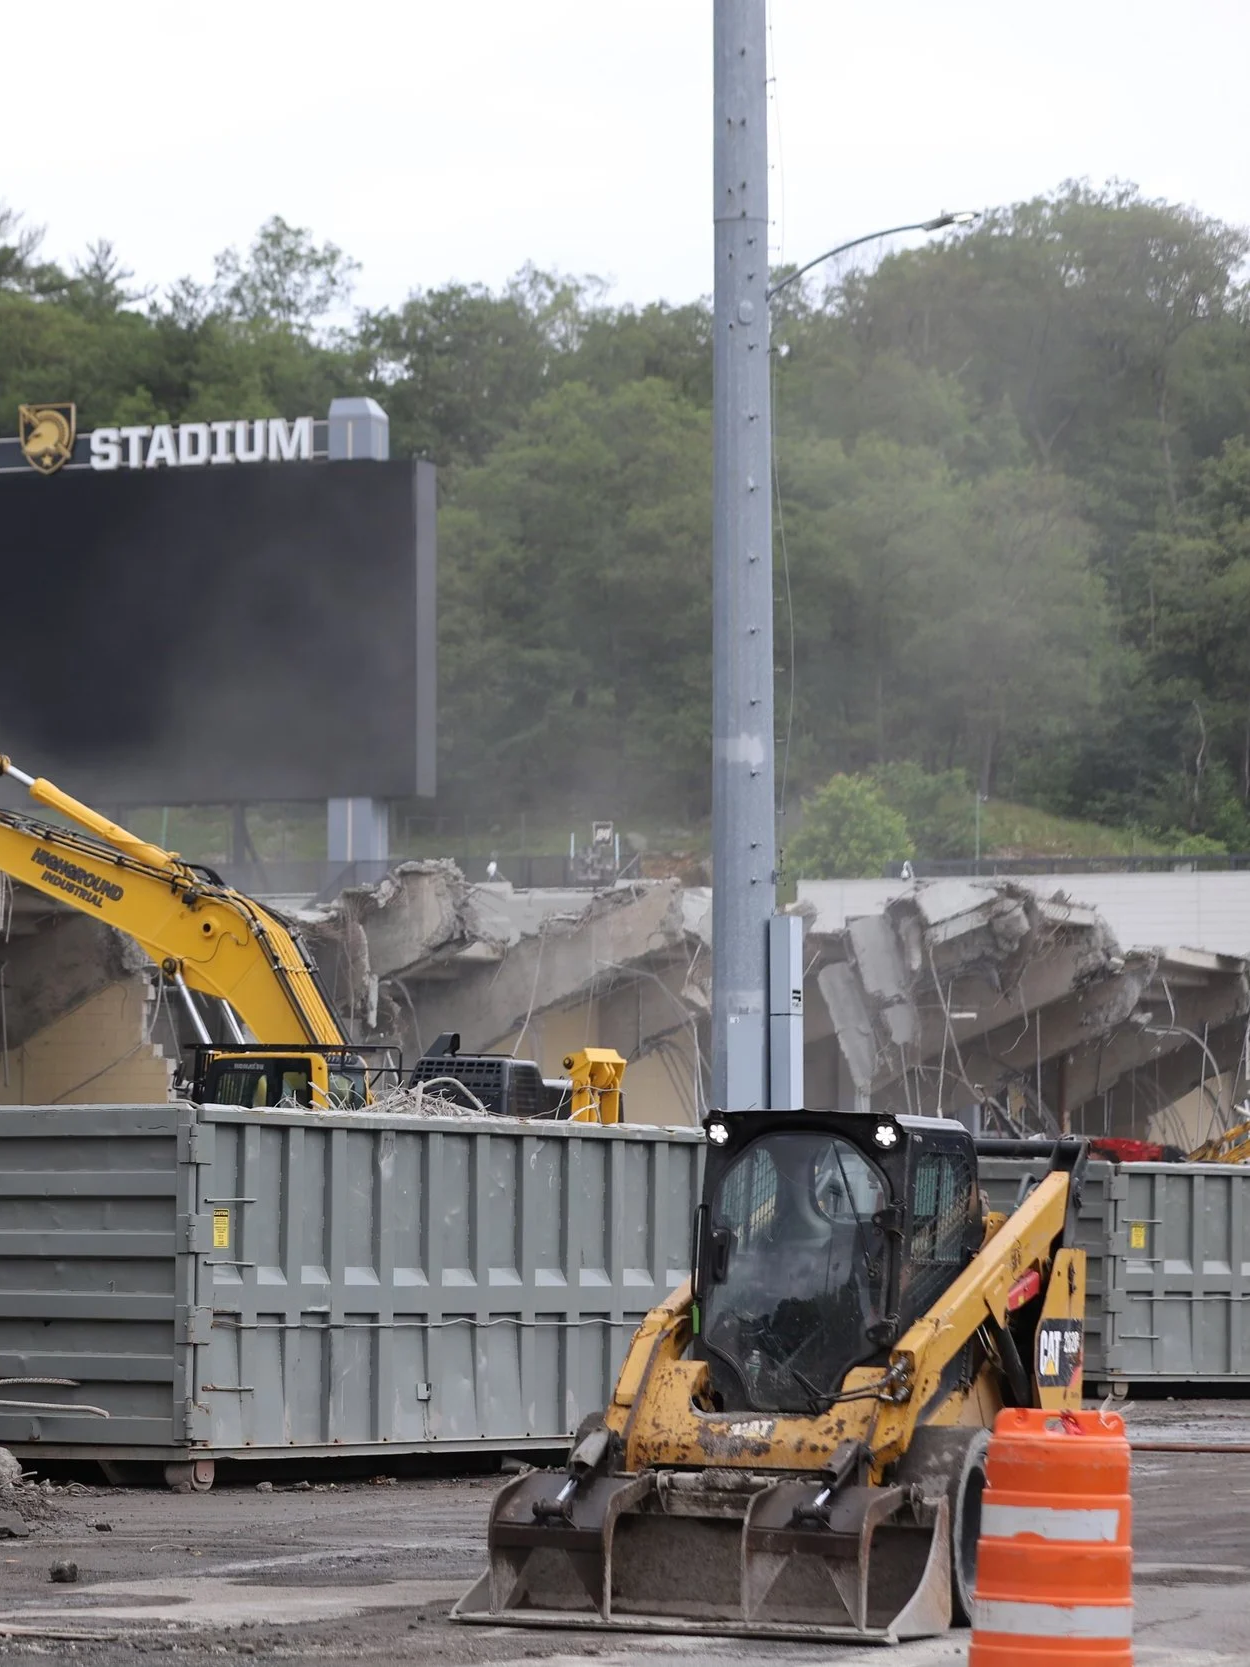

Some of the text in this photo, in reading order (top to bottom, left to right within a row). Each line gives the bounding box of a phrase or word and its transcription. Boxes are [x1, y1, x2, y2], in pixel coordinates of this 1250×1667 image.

[89, 415, 315, 472] STADIUM
[31, 847, 124, 902] HIGHGROUND
[41, 870, 103, 909] INDUSTRIAL
[1040, 1330, 1063, 1376] CAT
